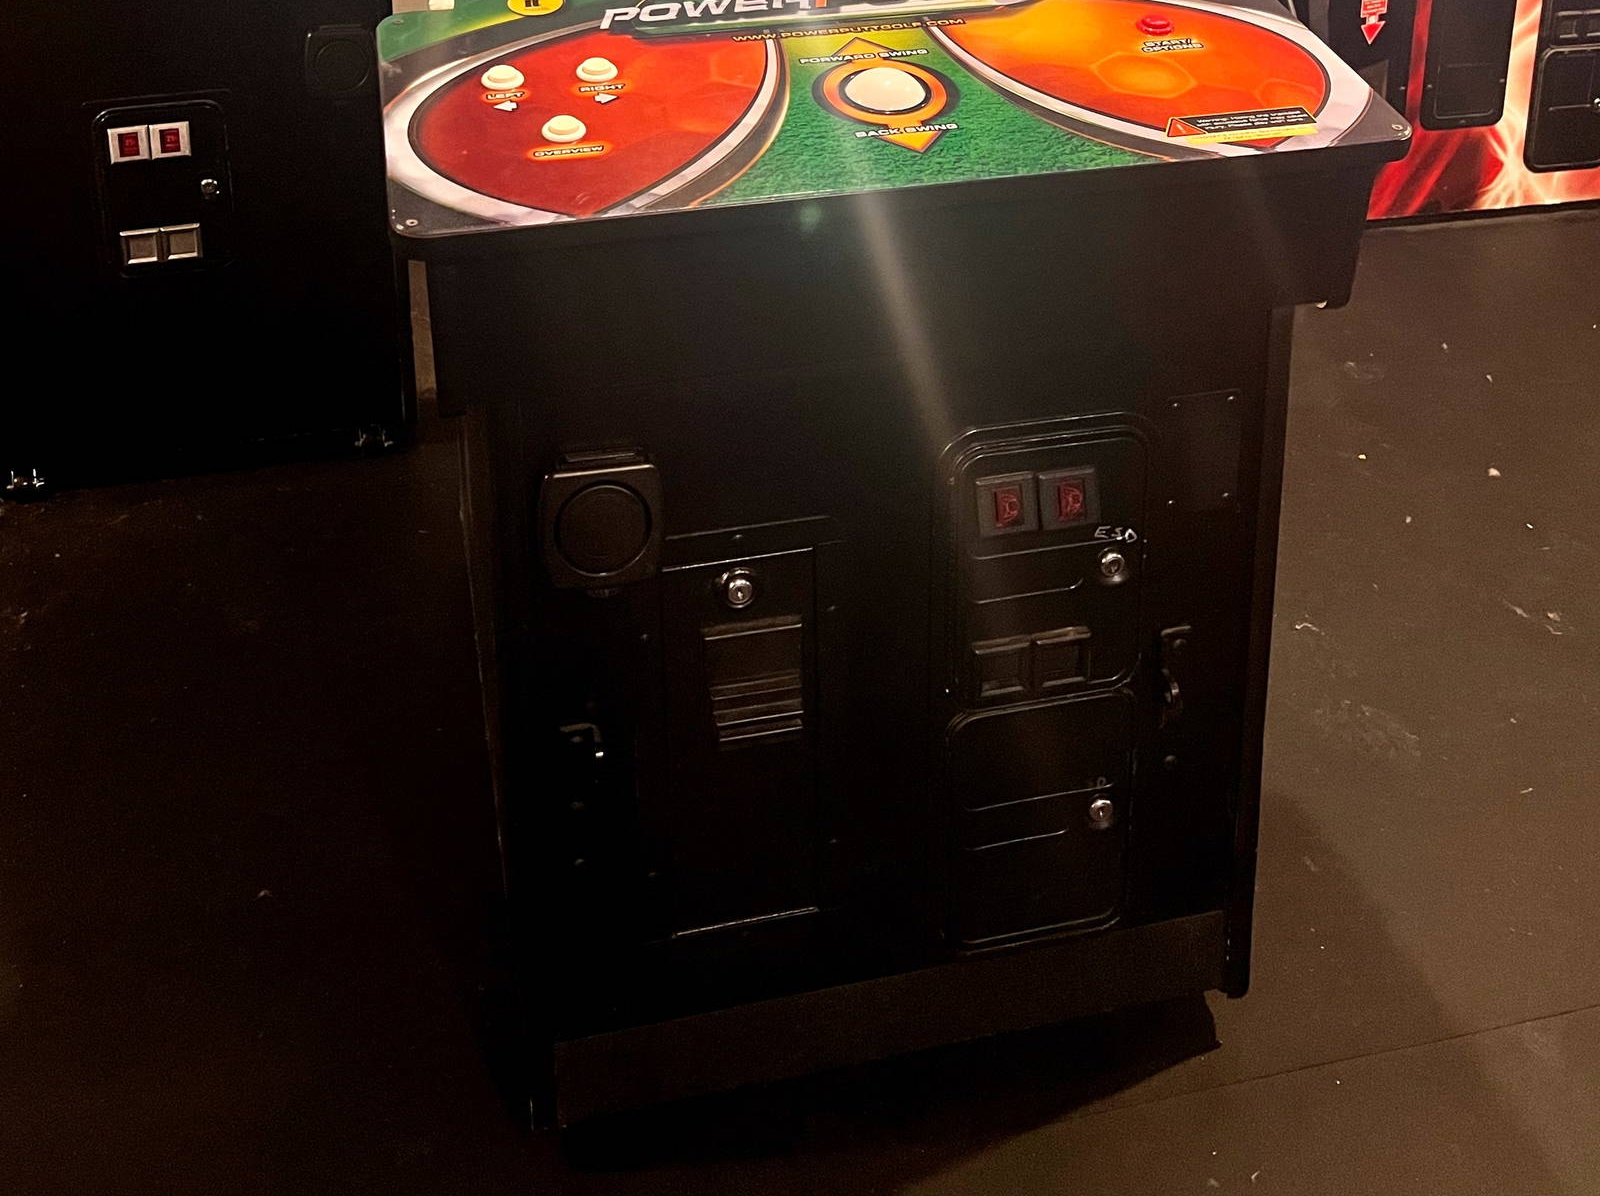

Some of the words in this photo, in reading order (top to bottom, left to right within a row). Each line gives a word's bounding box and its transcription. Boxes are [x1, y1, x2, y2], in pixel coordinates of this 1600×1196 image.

[1142, 43, 1204, 53] OPTIONS
[800, 52, 876, 64] FORWARD
[879, 48, 929, 59] SWING
[579, 83, 626, 93] RIGHT
[486, 91, 525, 101] LEFT
[855, 128, 900, 138] BACK
[904, 123, 959, 133] SWING
[533, 145, 605, 158] OVERVIEW
